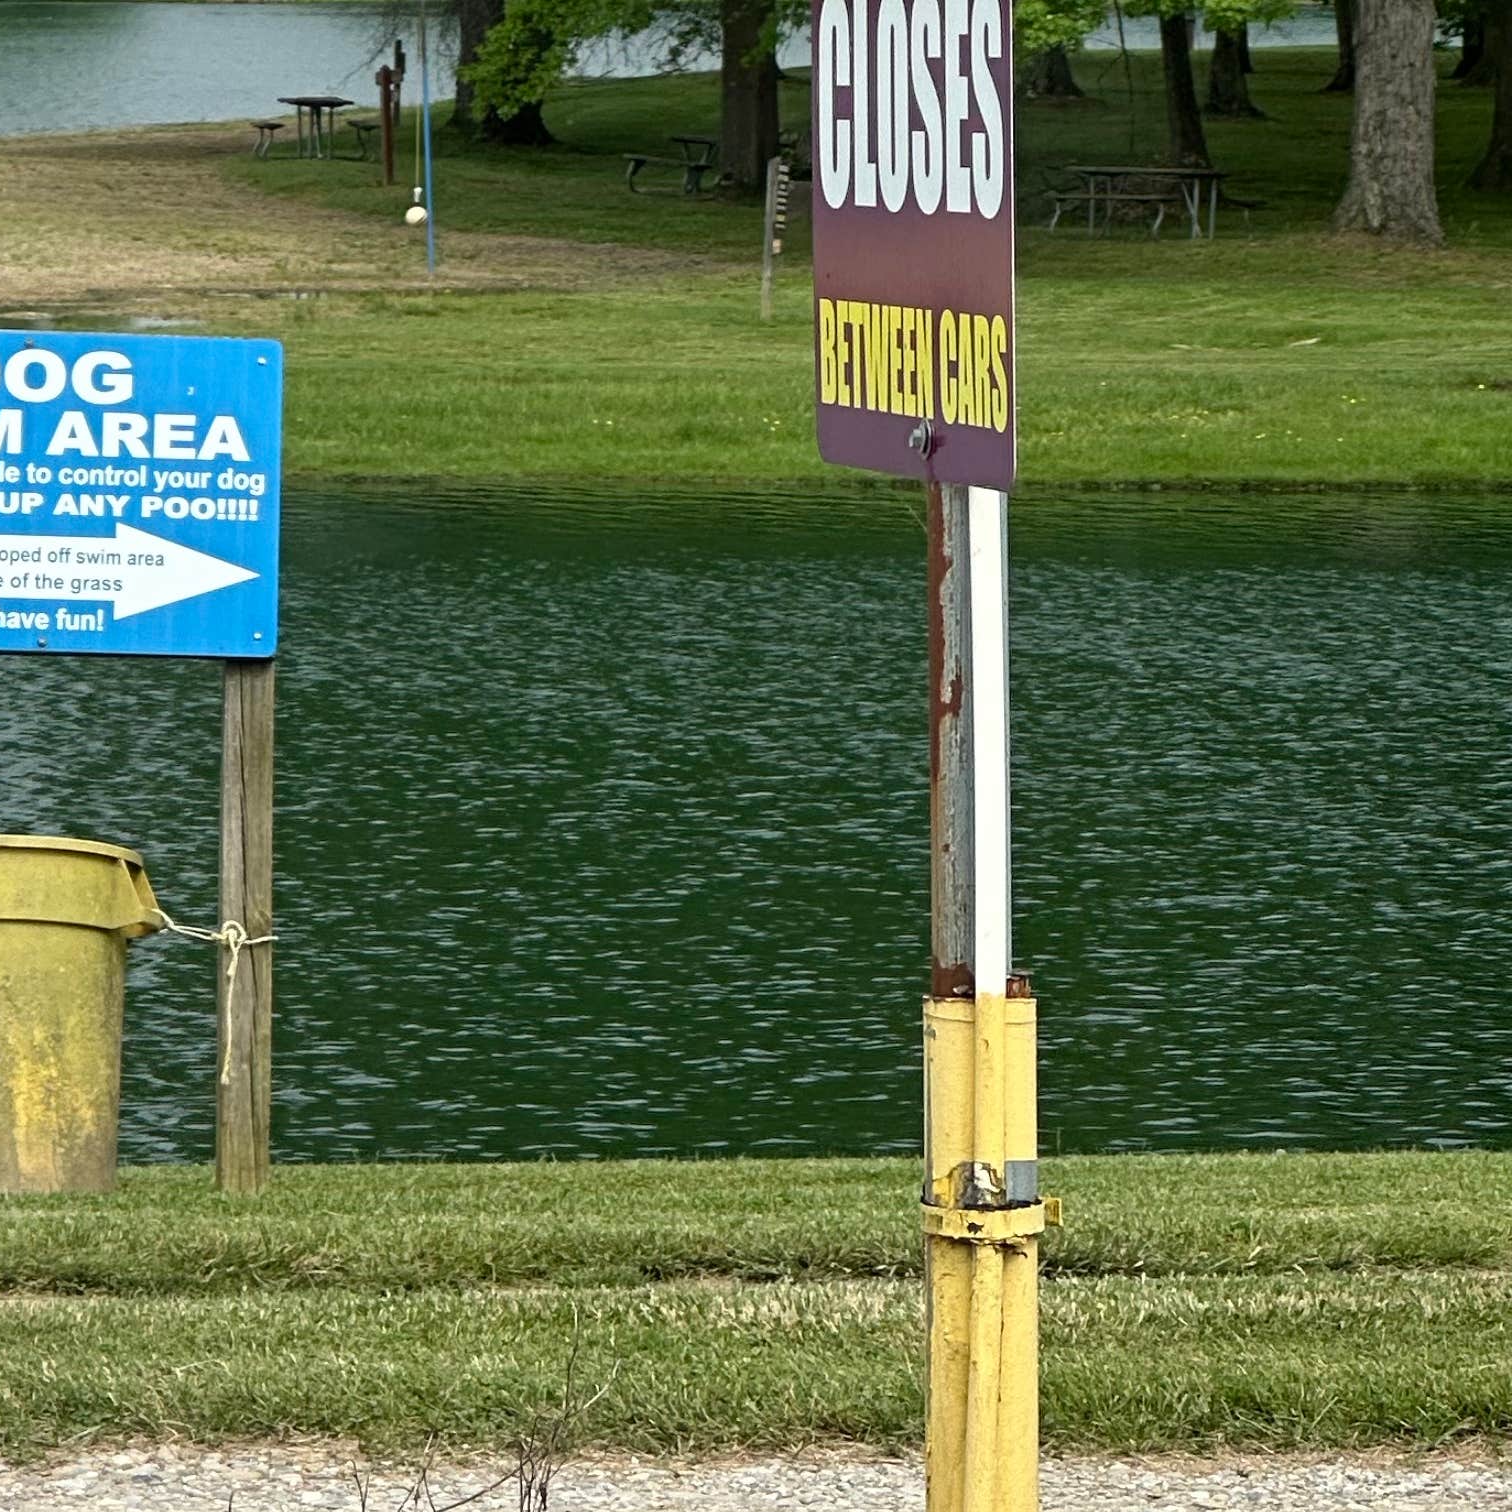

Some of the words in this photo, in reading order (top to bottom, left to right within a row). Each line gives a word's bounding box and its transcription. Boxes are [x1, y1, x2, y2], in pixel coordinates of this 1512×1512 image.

[818, 0, 1004, 219] CLOSES
[819, 298, 934, 420] BETWEEN
[939, 309, 1008, 433] CARS
[46, 411, 250, 462] AREA
[26, 464, 51, 484] to
[58, 465, 146, 487] control
[153, 471, 211, 490] your
[218, 470, 265, 495] dog
[53, 495, 131, 517] ANY
[141, 498, 259, 522] POO!!!!
[47, 548, 71, 565] off
[77, 550, 121, 565] swim
[127, 552, 164, 567] area
[11, 573, 31, 589] of
[36, 574, 65, 590] the
[71, 577, 123, 593] grass
[56, 608, 104, 632] fun!
